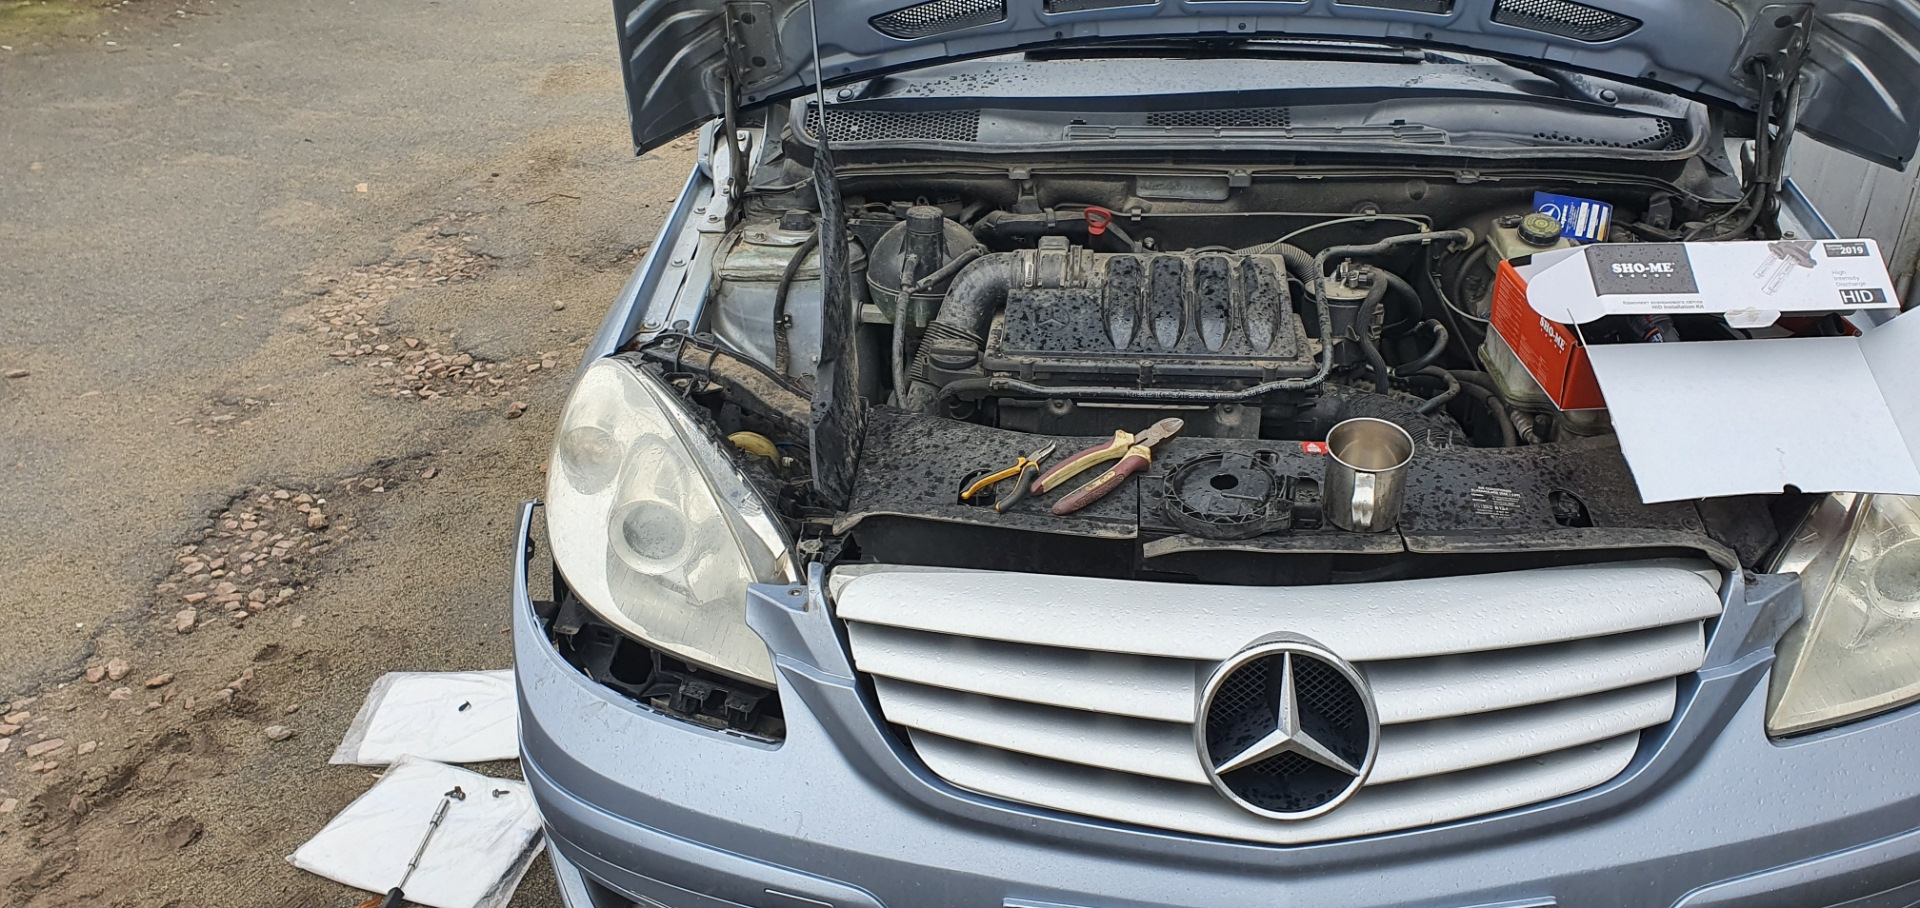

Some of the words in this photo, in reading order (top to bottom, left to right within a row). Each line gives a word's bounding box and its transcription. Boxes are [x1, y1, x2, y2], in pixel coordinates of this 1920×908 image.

[1840, 246, 1864, 254] 2019
[1611, 262, 1674, 273] SHO-ME
[1840, 290, 1874, 303] HID
[1540, 316, 1566, 351] SHO-ME
